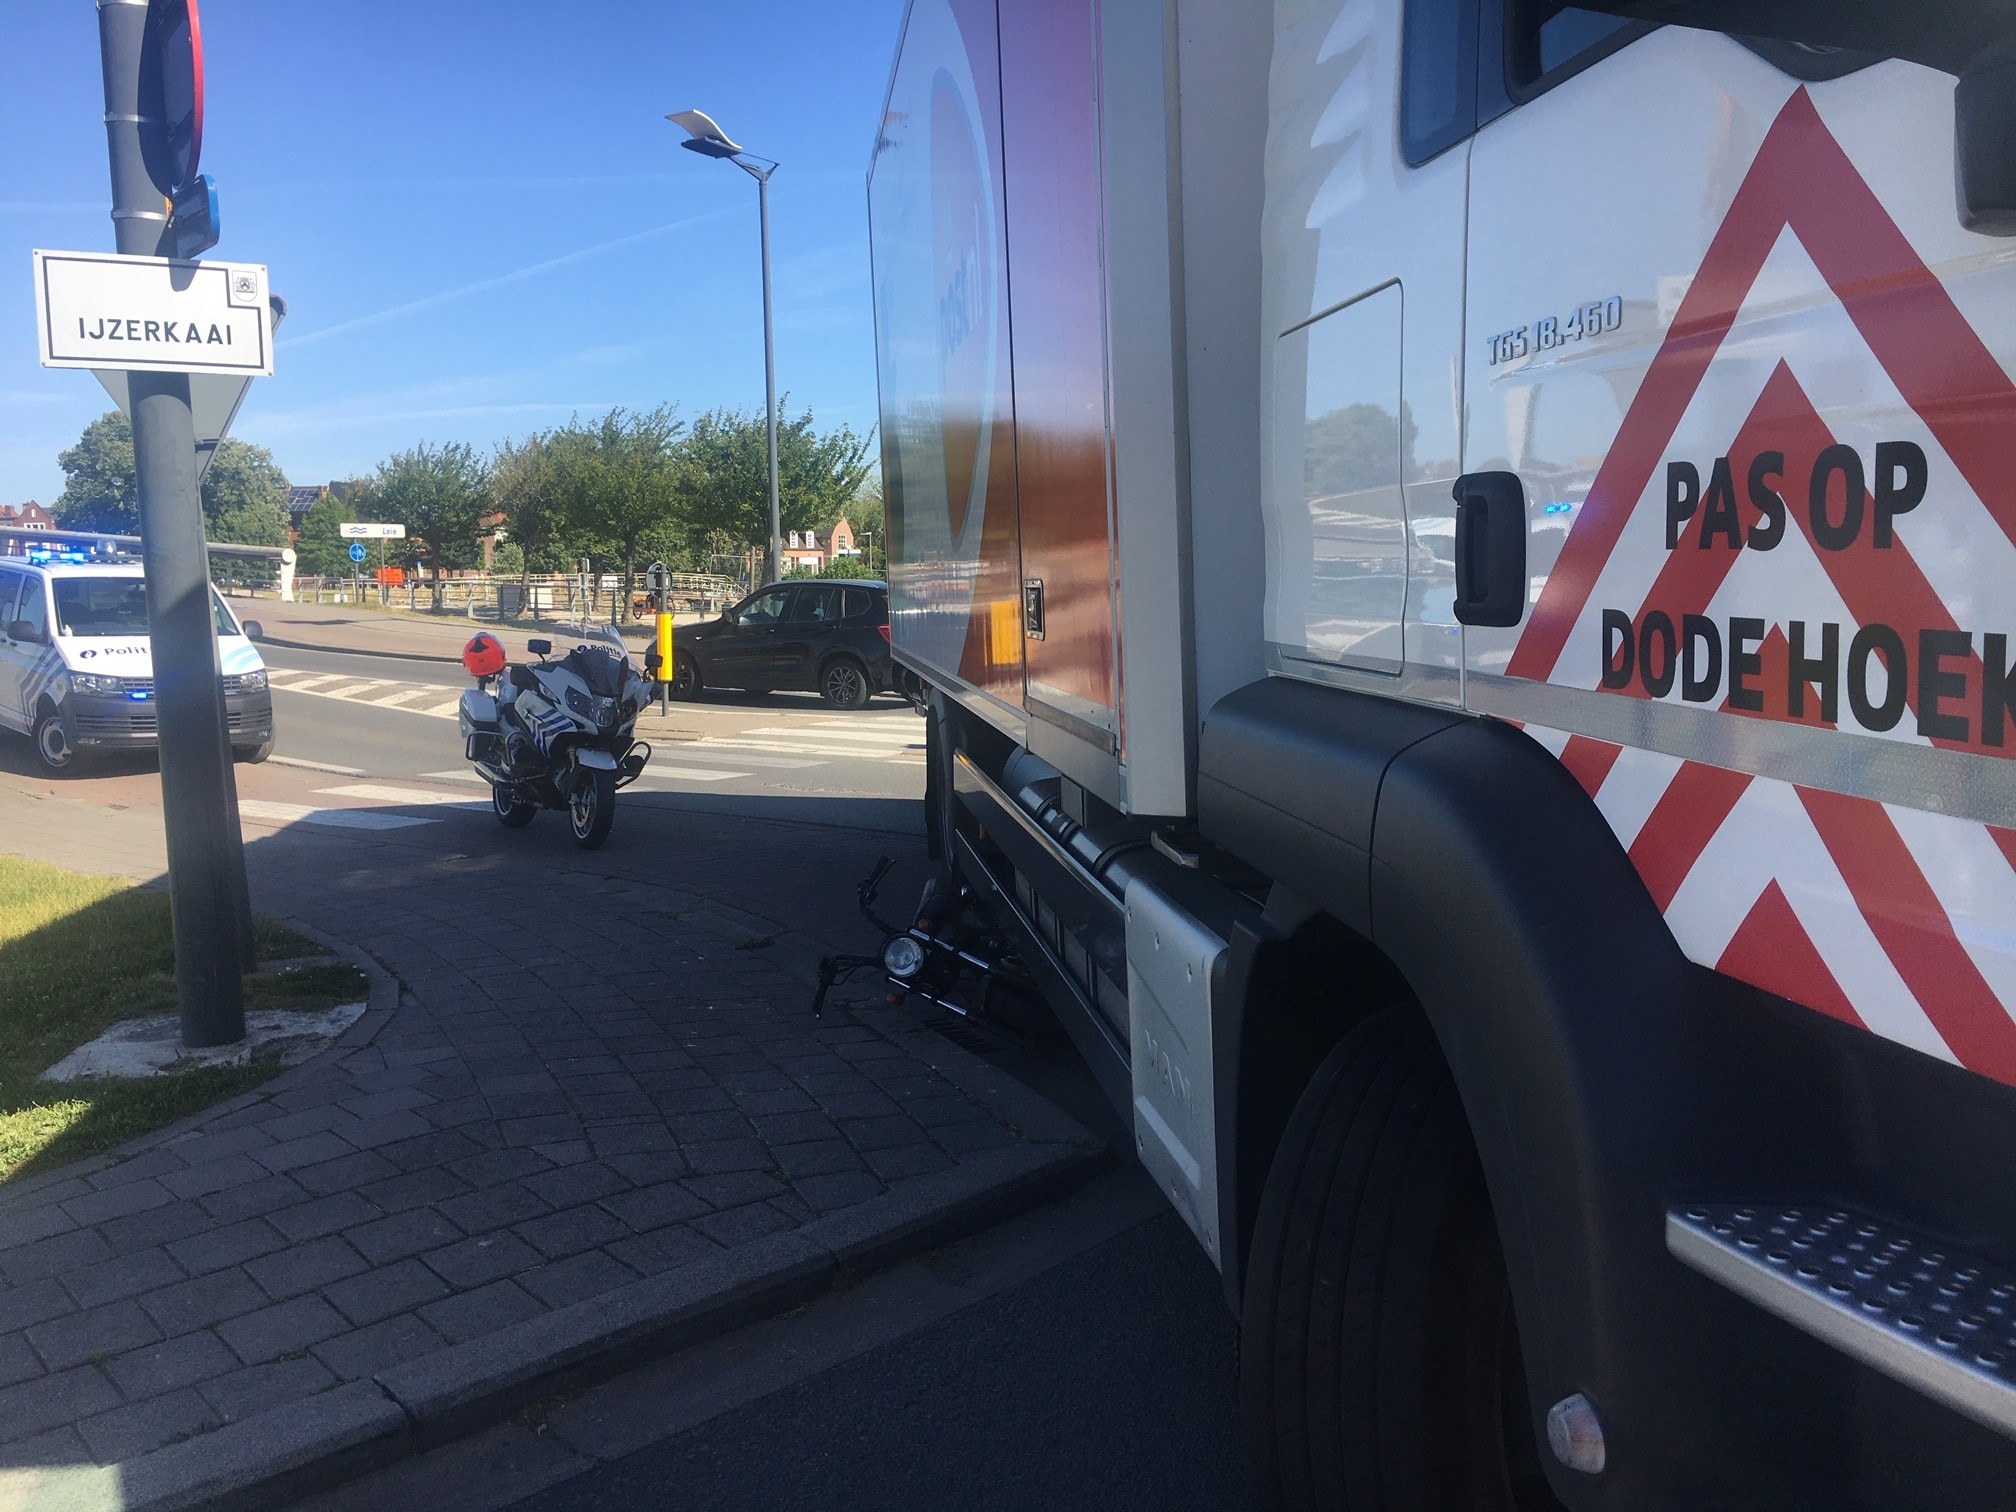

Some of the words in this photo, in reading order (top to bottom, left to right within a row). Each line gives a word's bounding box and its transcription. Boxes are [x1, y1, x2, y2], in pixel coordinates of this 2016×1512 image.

[78, 317, 233, 346] IJZERKAAI
[1486, 325, 1528, 366] TGS
[1531, 295, 1623, 352] 18.460
[1665, 450, 1787, 552] PAS
[1808, 440, 1928, 552] OP
[382, 527, 398, 536] Leie
[104, 646, 149, 655] Polit
[1602, 608, 1766, 713] DODE
